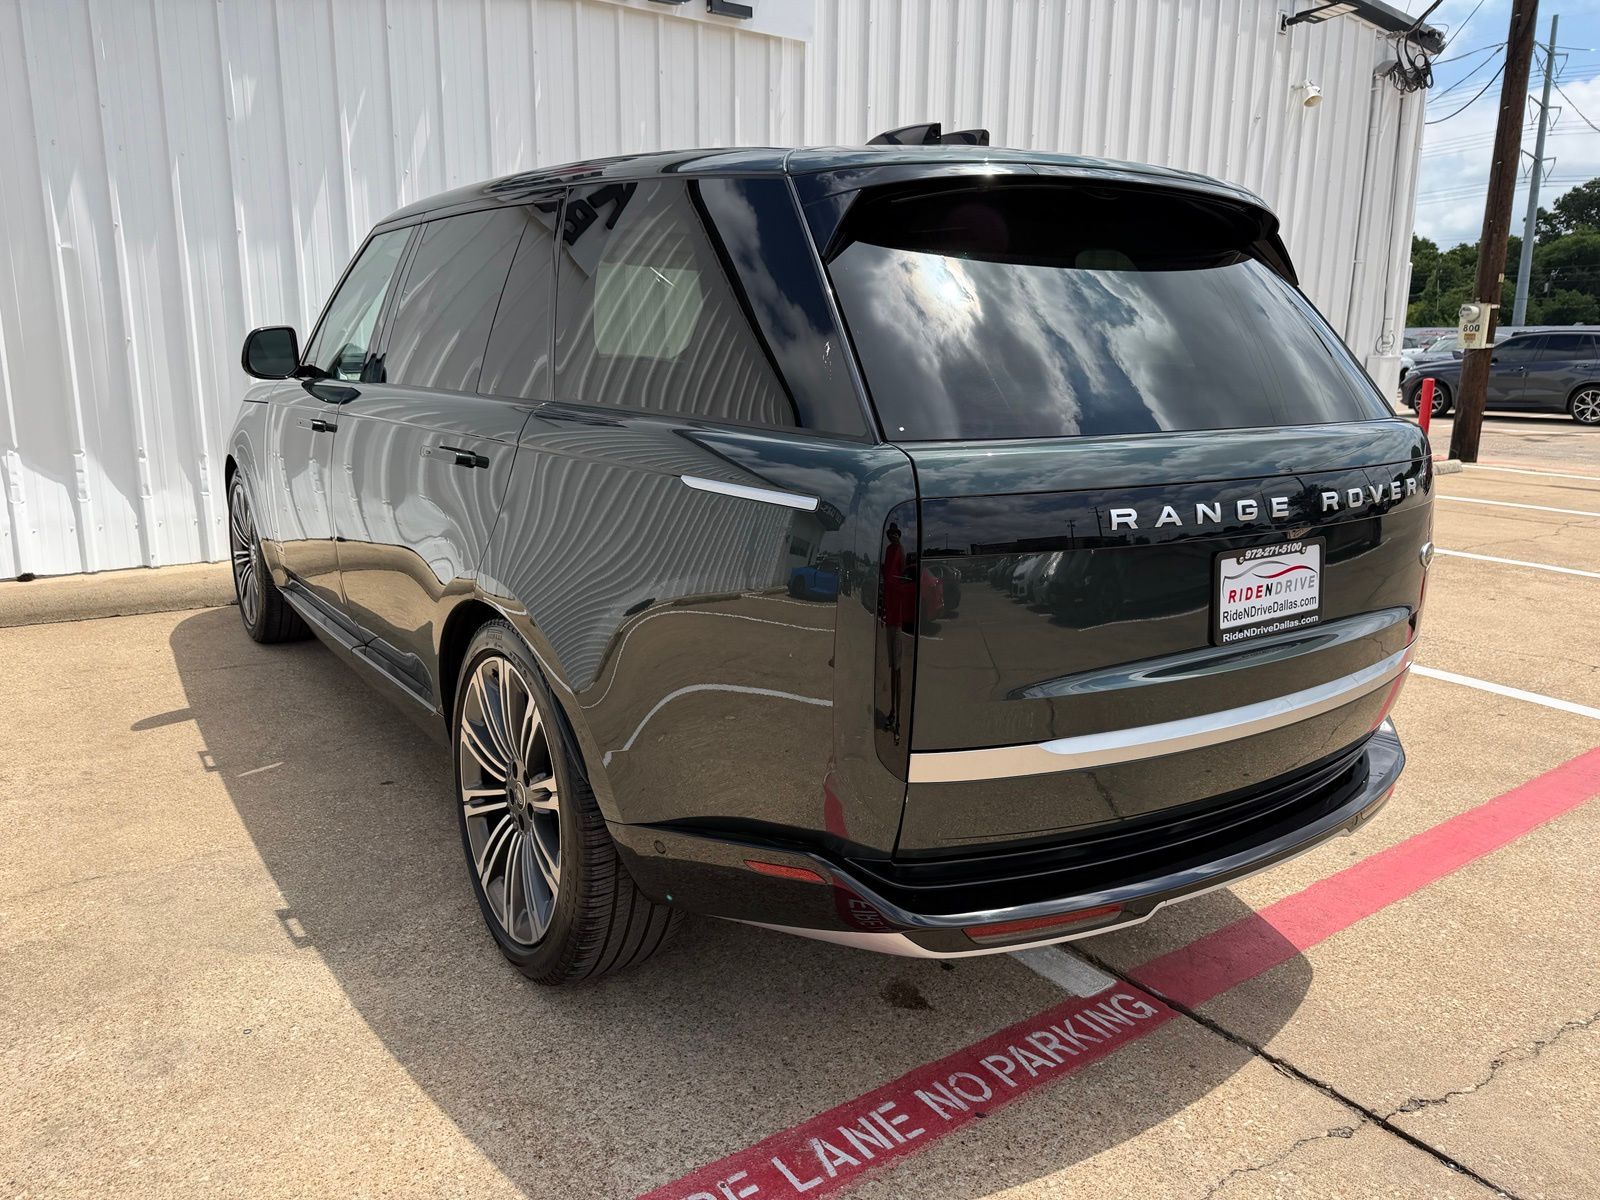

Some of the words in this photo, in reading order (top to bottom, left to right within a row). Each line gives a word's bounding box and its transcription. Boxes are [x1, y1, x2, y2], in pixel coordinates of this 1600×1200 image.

[1463, 324, 1480, 332] 800
[1109, 496, 1289, 531] RANGE
[1321, 477, 1417, 512] ROVER
[1245, 542, 1302, 559] 972-271-5100
[1228, 575, 1316, 604] RIDENDRIVE
[1222, 595, 1317, 623] RideNDriveDallas.com
[1222, 615, 1319, 642] RideNDriveDallas.com
[771, 1101, 926, 1192] LANE
[914, 1071, 993, 1121] NO
[979, 993, 1159, 1089] PARKING
